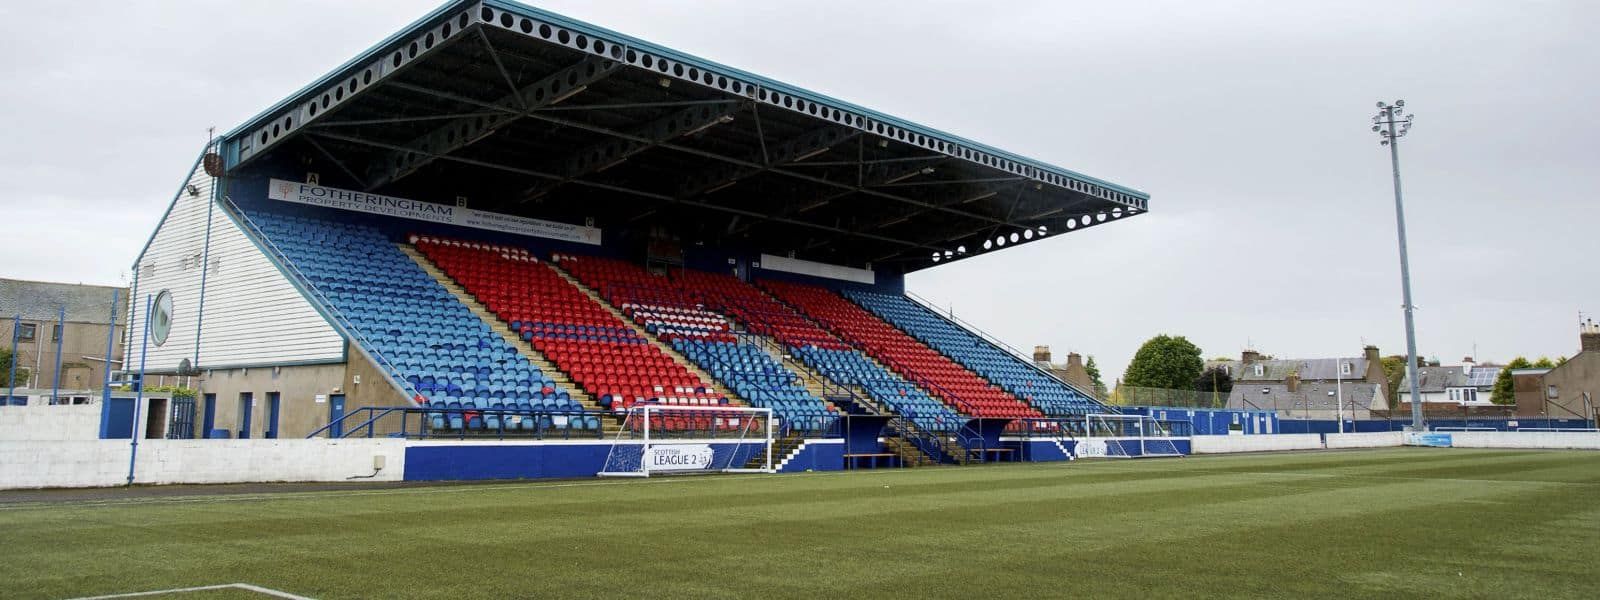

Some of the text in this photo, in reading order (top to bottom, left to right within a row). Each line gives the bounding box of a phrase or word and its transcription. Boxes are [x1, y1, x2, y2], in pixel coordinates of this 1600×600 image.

[308, 174, 317, 184] A
[300, 185, 453, 216] FOTHERINGHAM
[299, 196, 453, 223] PROPERTY DEVELOPMENTS
[587, 218, 593, 227] C
[654, 455, 689, 465] LEAGUE
[691, 454, 697, 464] 2
